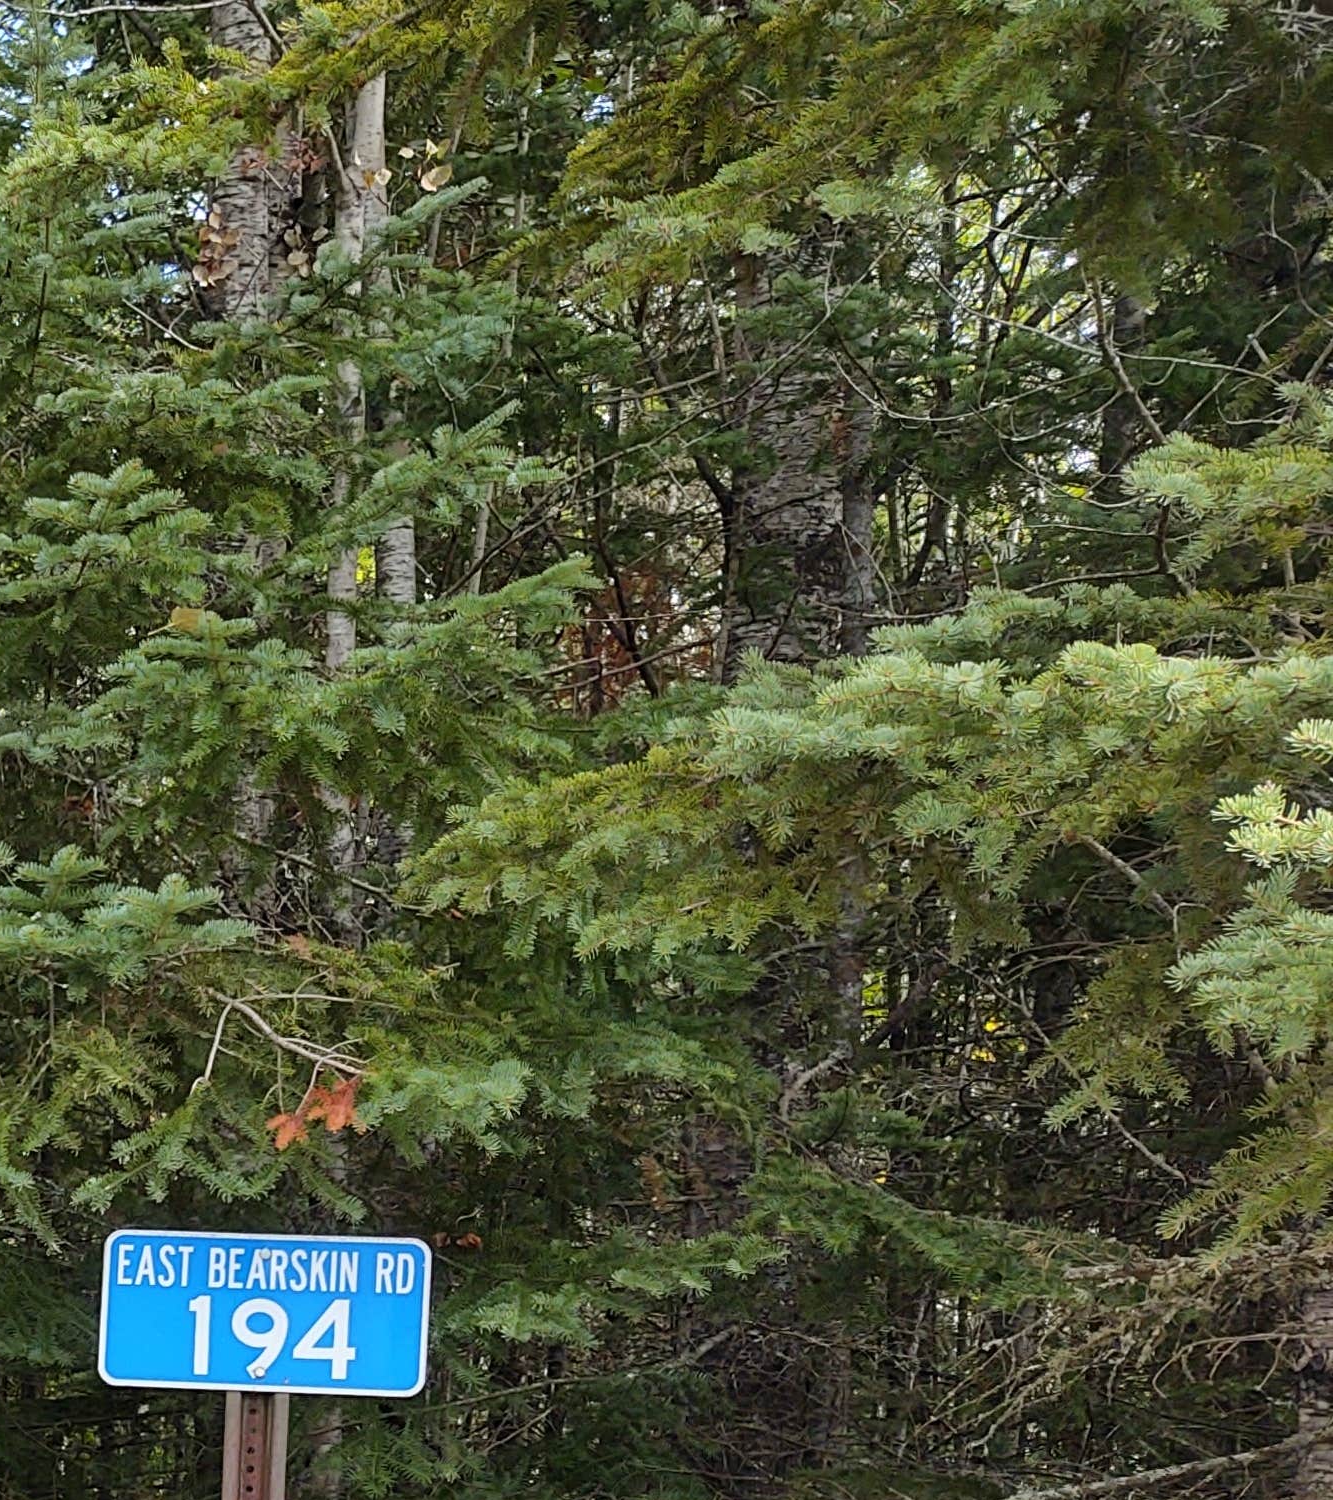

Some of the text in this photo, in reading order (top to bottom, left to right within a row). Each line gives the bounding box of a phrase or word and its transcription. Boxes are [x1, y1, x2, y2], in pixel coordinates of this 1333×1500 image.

[117, 1244, 415, 1294] EAST BEARSKIN RD
[188, 1295, 356, 1380] 194
